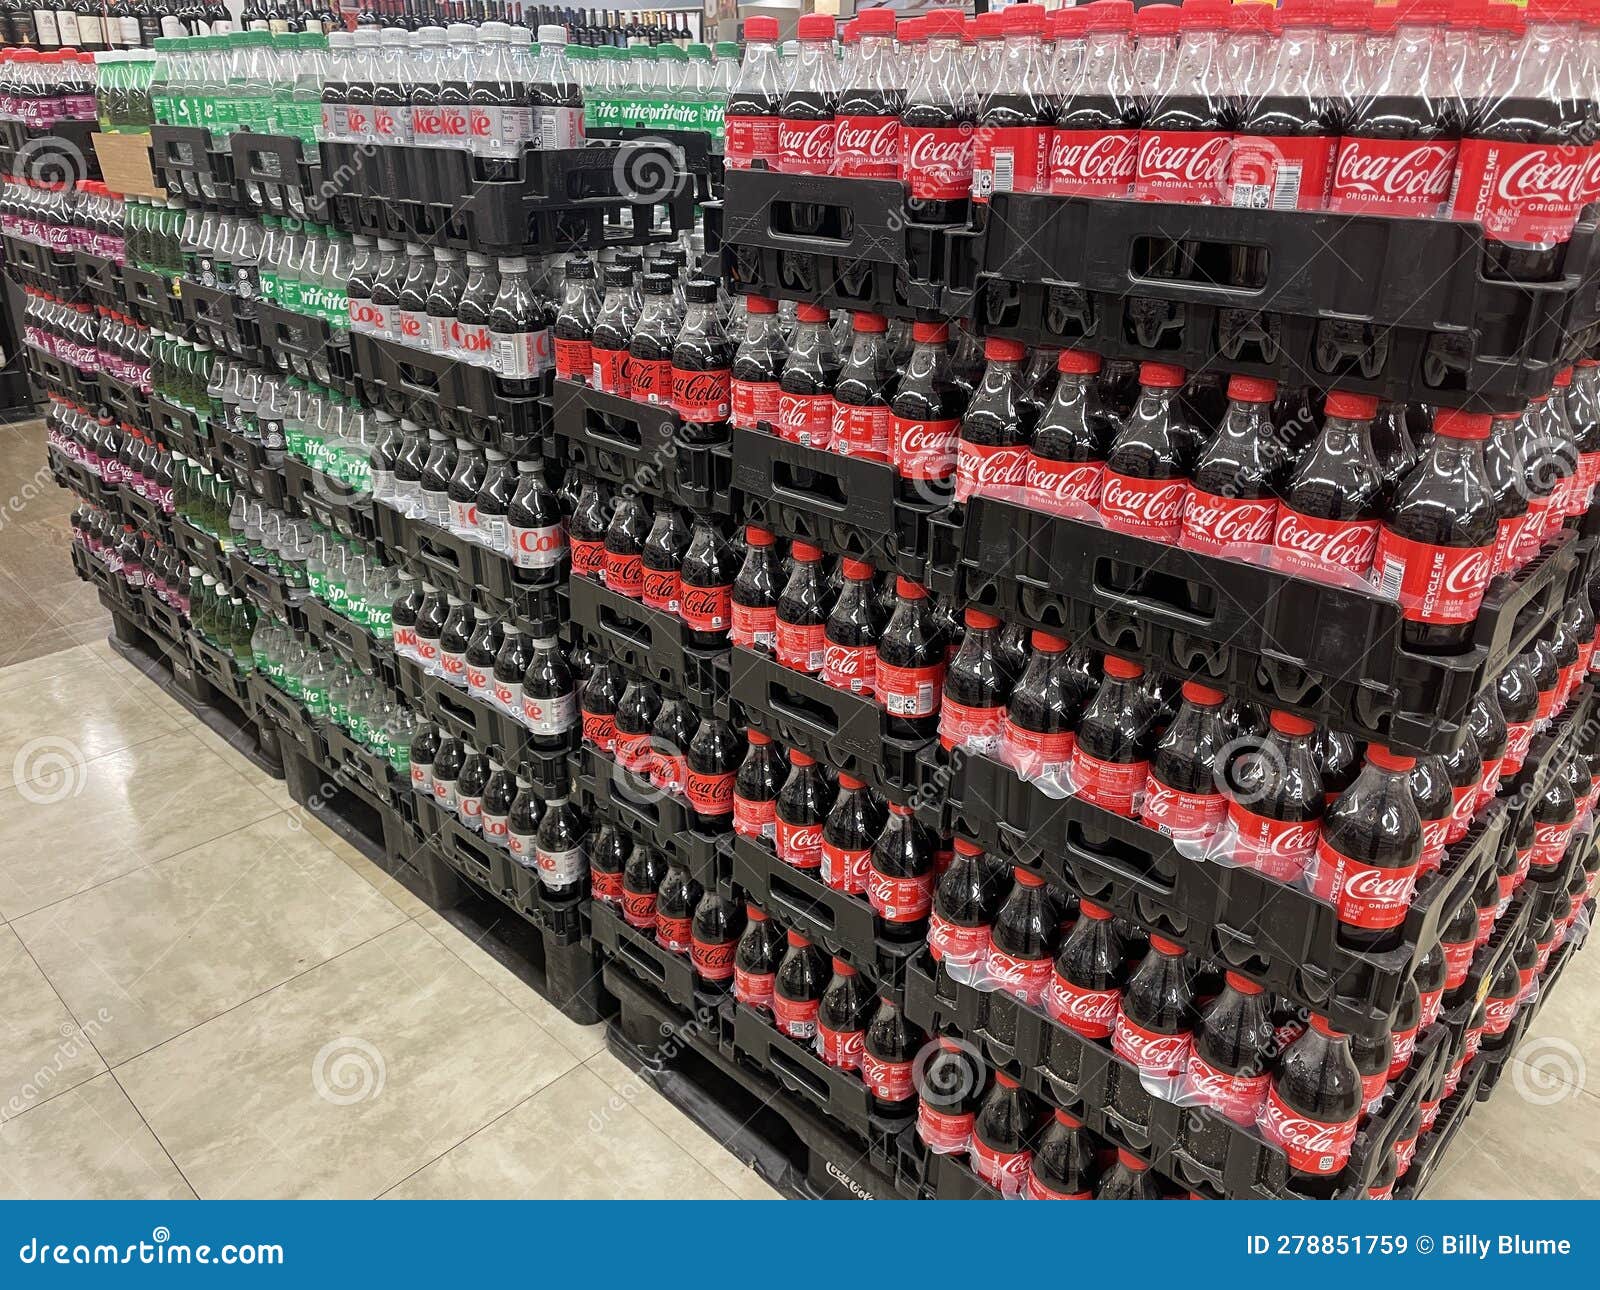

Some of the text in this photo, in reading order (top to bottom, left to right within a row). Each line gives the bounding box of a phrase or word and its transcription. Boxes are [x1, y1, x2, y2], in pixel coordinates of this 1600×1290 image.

[1486, 149, 1499, 170] ME
[1335, 142, 1457, 195] Coca-Cola
[1055, 177, 1088, 185] ORIGINAL
[1152, 181, 1194, 189] ORIGINAL
[1346, 192, 1430, 204] ORIGINAL TASTE
[1113, 515, 1178, 527] ORIGINAL TASTE
[1183, 492, 1277, 541] Coca-Cola
[1187, 532, 1222, 546] ORIGINAL
[1275, 516, 1380, 565] Coca-Cola
[1286, 556, 1329, 571] ORIGINAL
[1422, 552, 1445, 617] RECYCLE ME
[1261, 822, 1269, 835] ME
